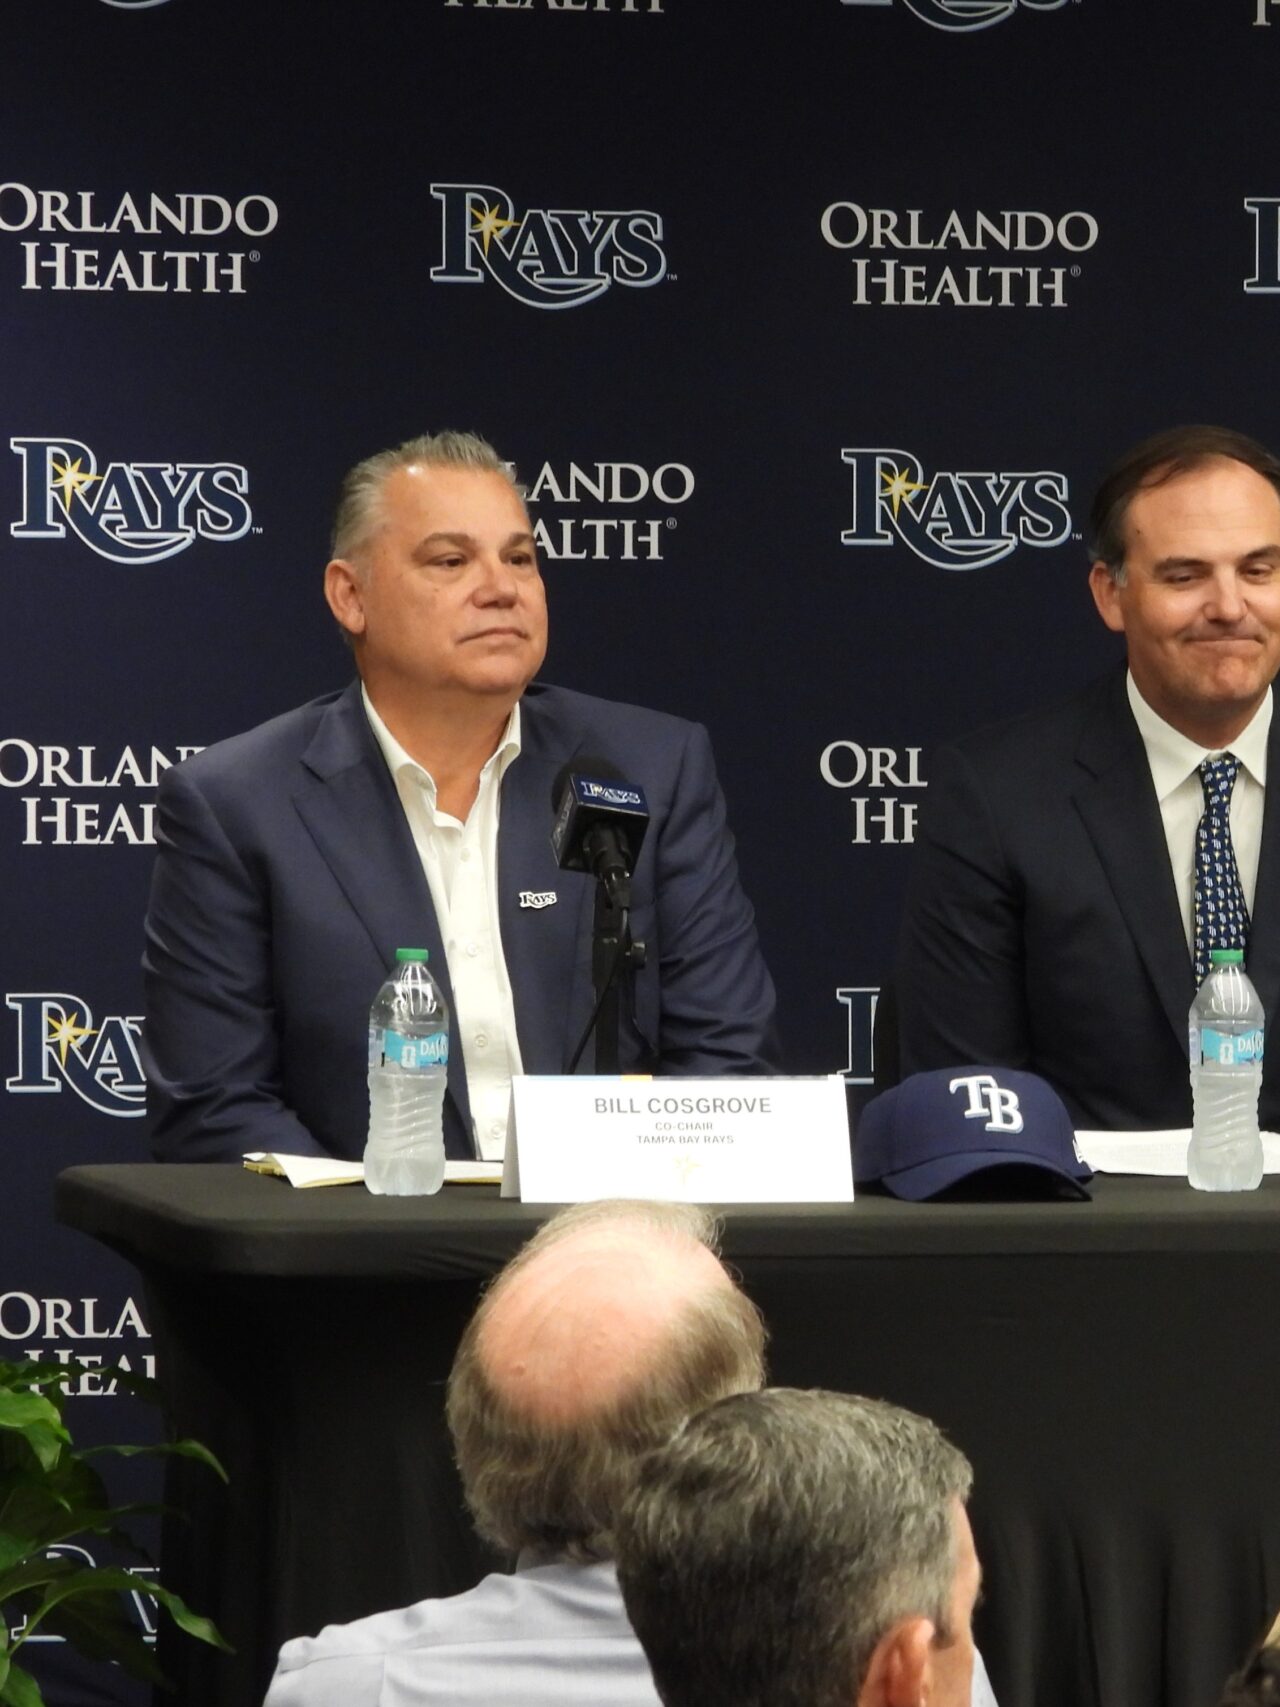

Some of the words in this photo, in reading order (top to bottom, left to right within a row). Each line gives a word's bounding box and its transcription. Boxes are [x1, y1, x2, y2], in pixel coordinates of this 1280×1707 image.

[0, 182, 279, 237] ORLANDO
[821, 202, 1099, 252] ORLANDO
[430, 183, 667, 309] RAYS
[10, 437, 252, 564] RAYS
[505, 461, 695, 504] ANDO
[841, 448, 1072, 570] RAYS
[532, 518, 664, 560] ALTH
[0, 738, 208, 788] ORLAN
[21, 797, 157, 845] HEAL
[6, 993, 147, 1118] RA
[595, 1098, 641, 1114] BILL
[647, 1097, 772, 1114] COSGROVE
[655, 1121, 714, 1131] CO-CHAIR
[949, 1075, 1024, 1134] TB
[637, 1135, 676, 1144] TAMPA
[679, 1135, 701, 1144] BAY
[704, 1135, 735, 1144] RAYS
[0, 1291, 152, 1340] ORLA
